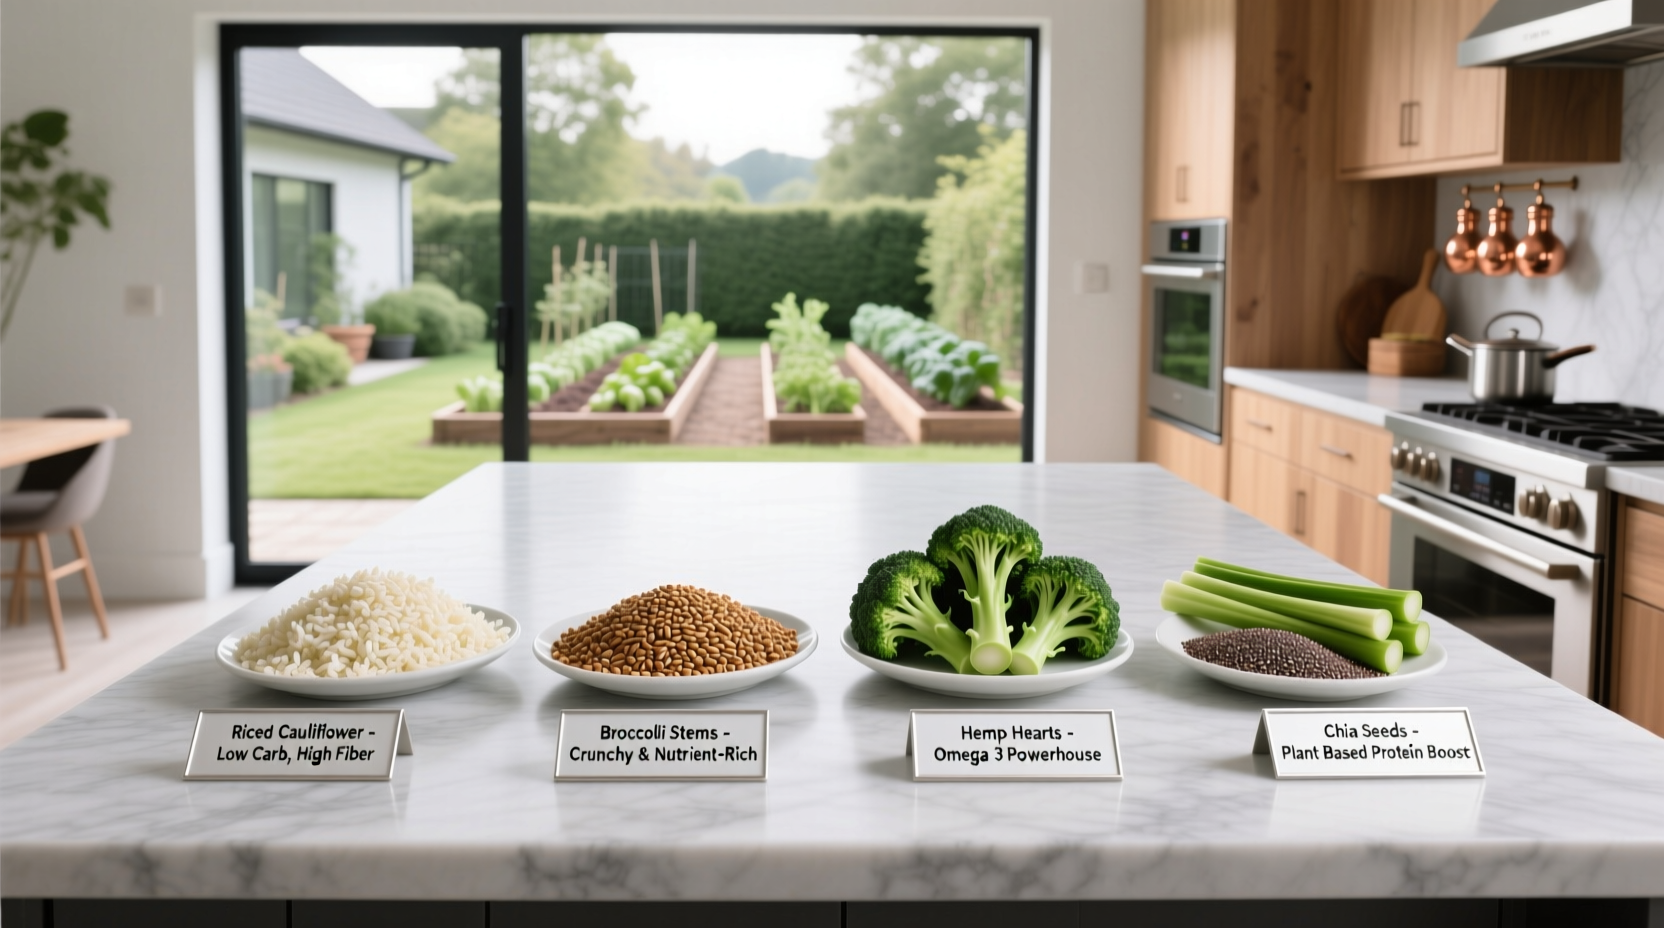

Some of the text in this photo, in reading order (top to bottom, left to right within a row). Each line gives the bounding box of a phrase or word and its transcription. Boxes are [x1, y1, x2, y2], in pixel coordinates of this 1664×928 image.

[232, 724, 273, 739] Riced
[279, 723, 364, 739] Cauliflower
[601, 724, 665, 740] Broccoli
[670, 725, 718, 740] Stems
[962, 726, 1007, 744] Hemp
[1013, 726, 1061, 740] Hearts
[1324, 723, 1358, 737] Chia
[1362, 722, 1407, 737] Seeds
[217, 745, 375, 766] Low Carb, High Fiber
[570, 746, 757, 765] Crunchy & Nutrient-Rich
[934, 746, 1101, 766] Omega 3 Powerhouse
[1282, 744, 1471, 759] Plant Based Protein Boost
